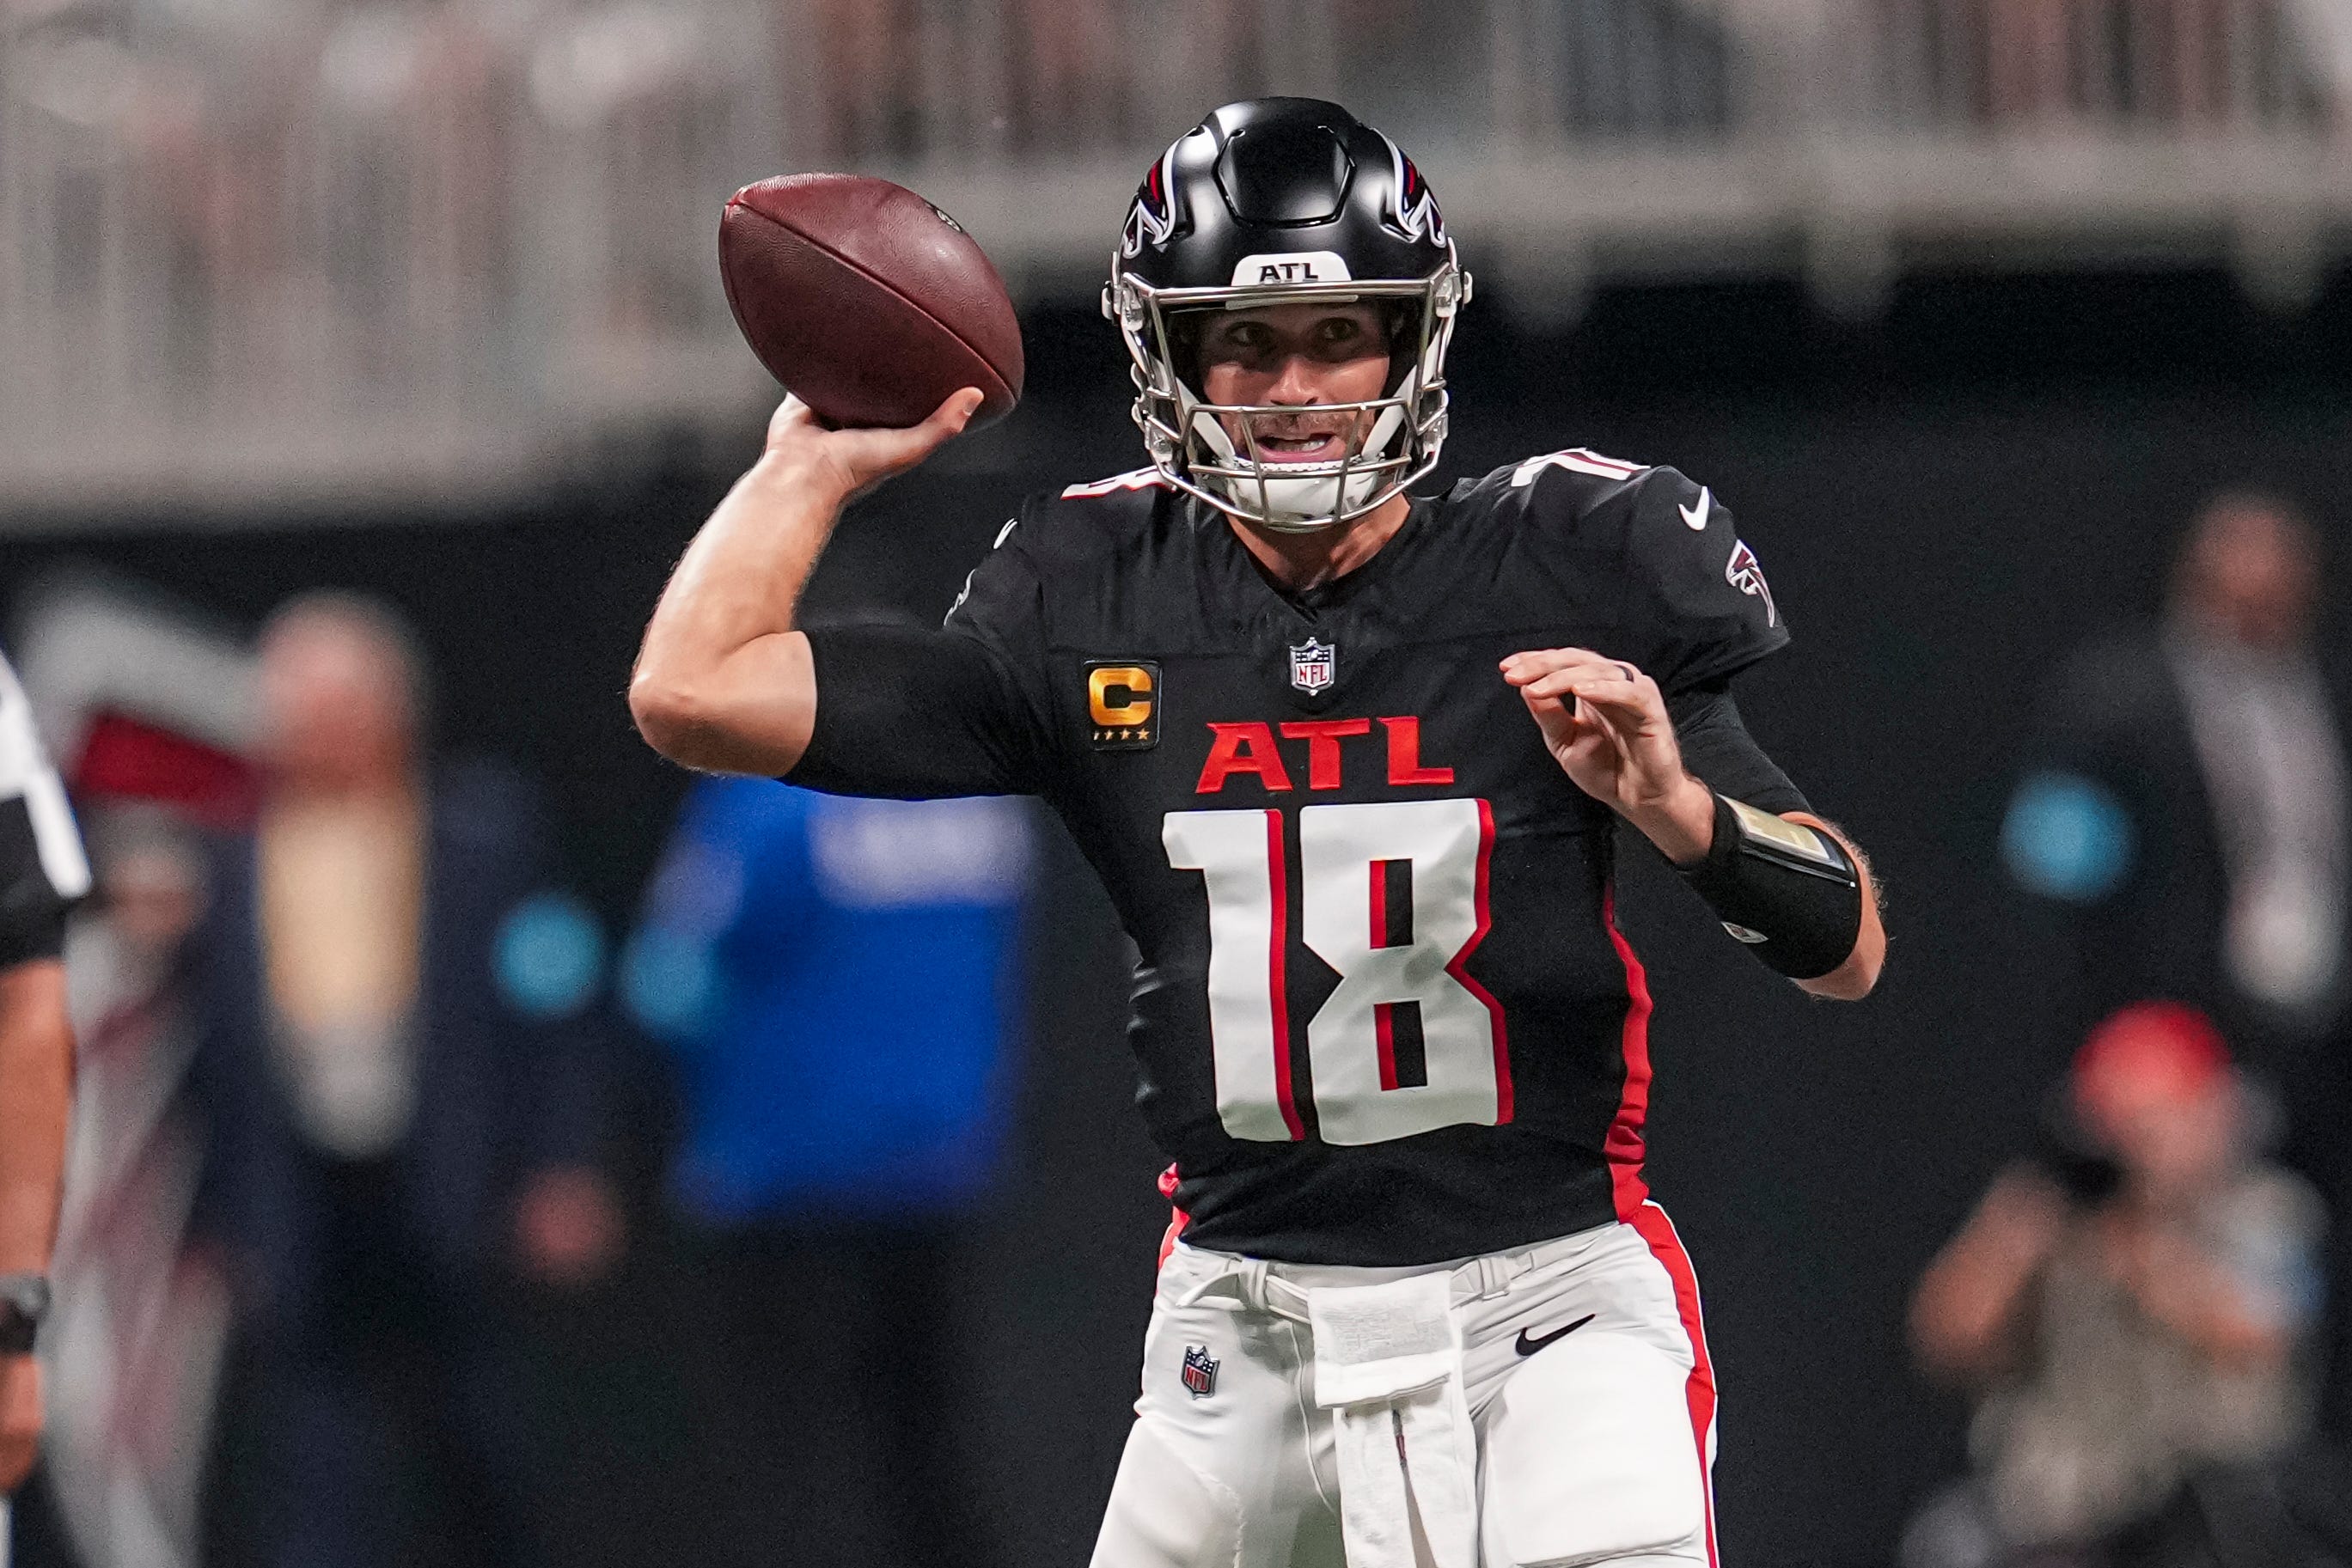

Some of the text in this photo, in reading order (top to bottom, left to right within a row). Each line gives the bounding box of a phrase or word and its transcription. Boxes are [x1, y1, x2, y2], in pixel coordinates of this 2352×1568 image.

[1258, 263, 1319, 283] ATL
[1088, 667, 1152, 726] C
[1296, 664, 1328, 685] NFL
[1195, 716, 1454, 794] ATL
[1162, 798, 1514, 1145] 18
